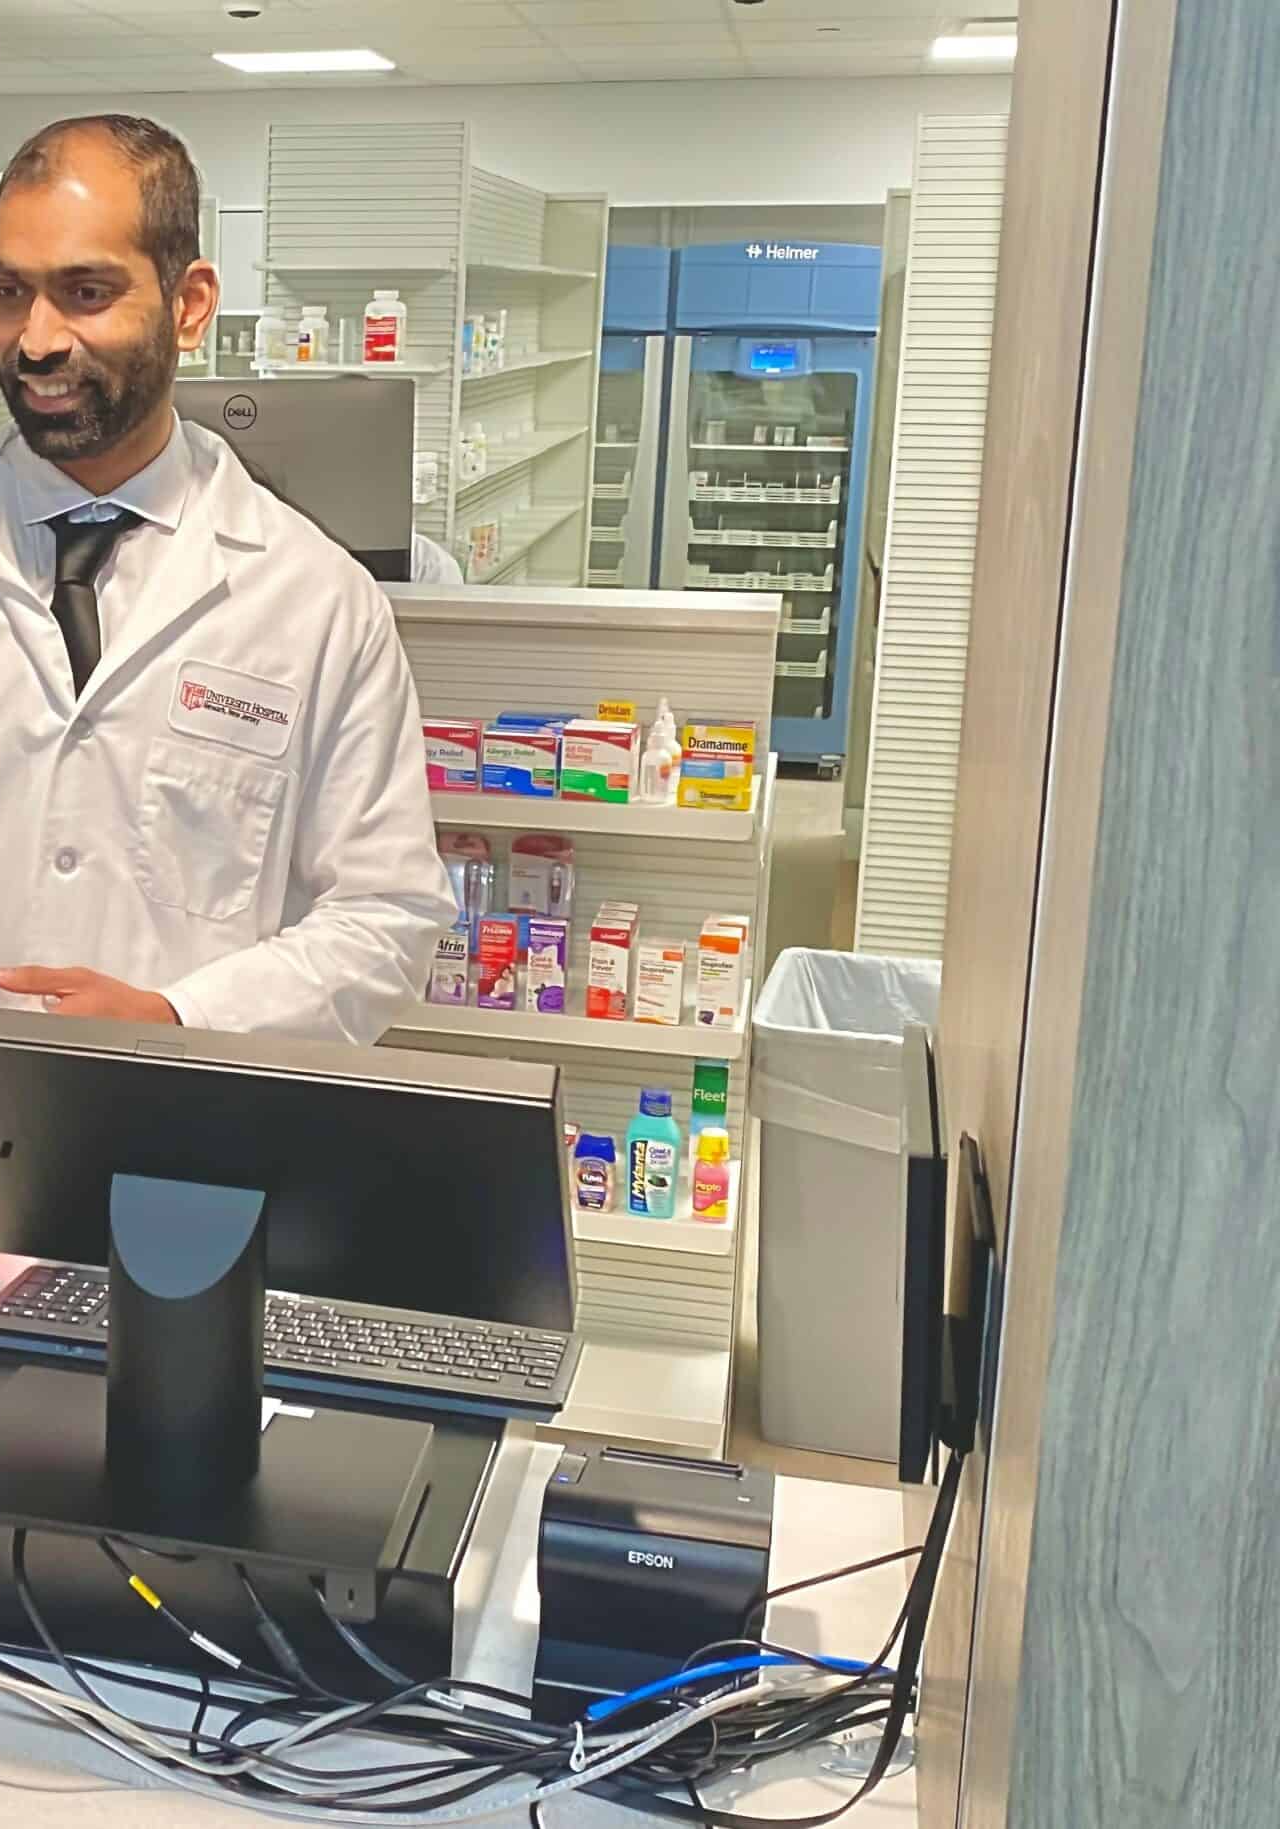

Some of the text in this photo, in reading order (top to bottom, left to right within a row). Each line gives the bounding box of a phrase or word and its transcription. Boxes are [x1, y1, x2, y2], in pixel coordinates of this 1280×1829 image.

[766, 244, 819, 260] Helmer
[228, 407, 254, 417] DELL
[206, 689, 288, 721] UNIVERSITY HOSPITAL
[688, 736, 749, 752] Dramamine
[438, 940, 465, 952] Afrin
[694, 1088, 726, 1103] Fleet
[628, 1550, 673, 1569] EPSON
